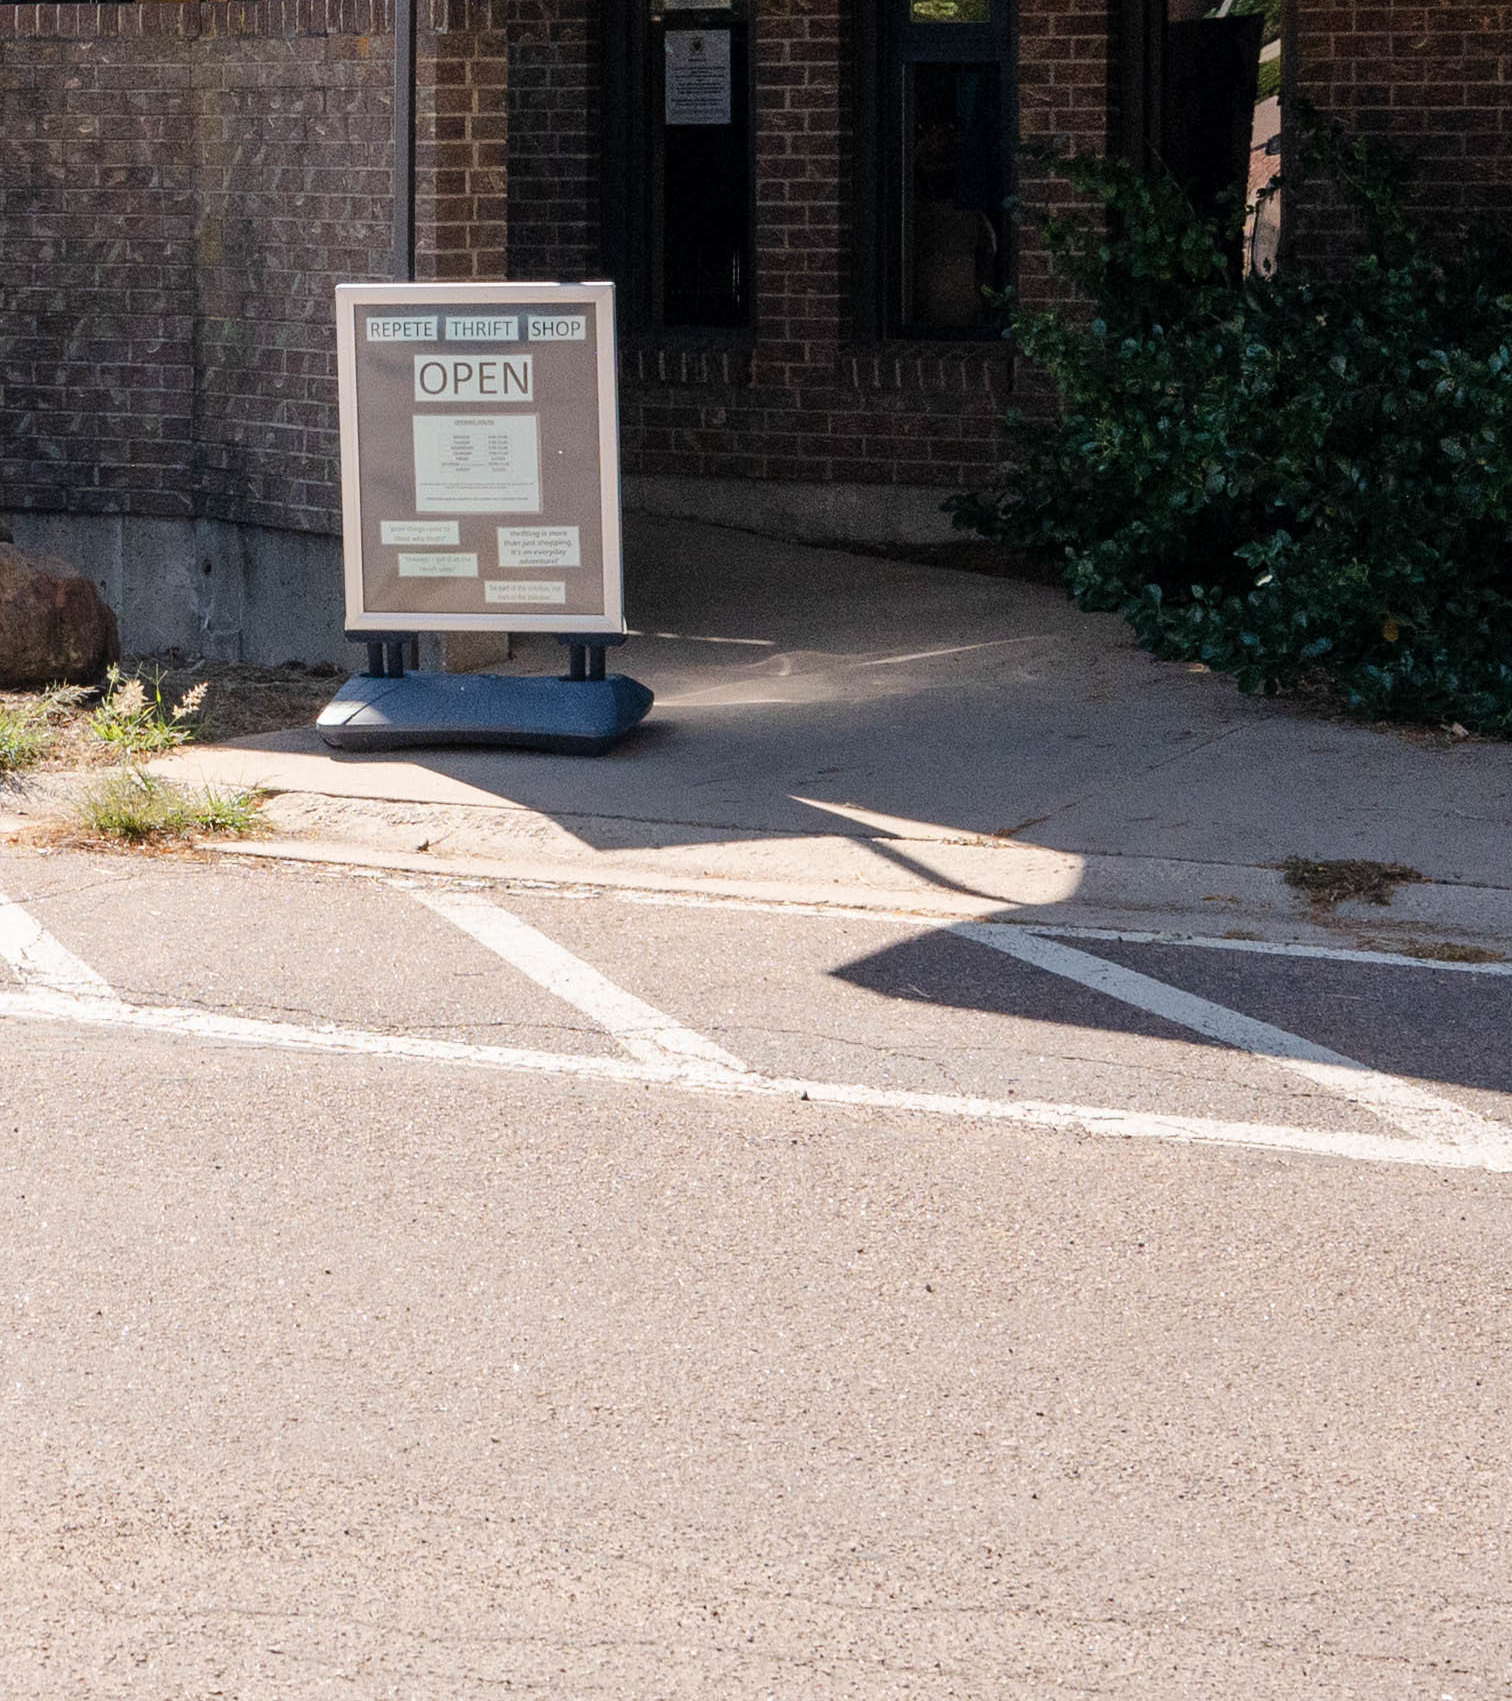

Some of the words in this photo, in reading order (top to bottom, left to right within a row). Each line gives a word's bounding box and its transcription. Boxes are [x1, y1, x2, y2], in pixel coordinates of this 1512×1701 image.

[370, 321, 433, 337] REPETE
[451, 321, 513, 337] THRIFT
[531, 321, 582, 337] SHOP
[419, 361, 529, 395] OPEN
